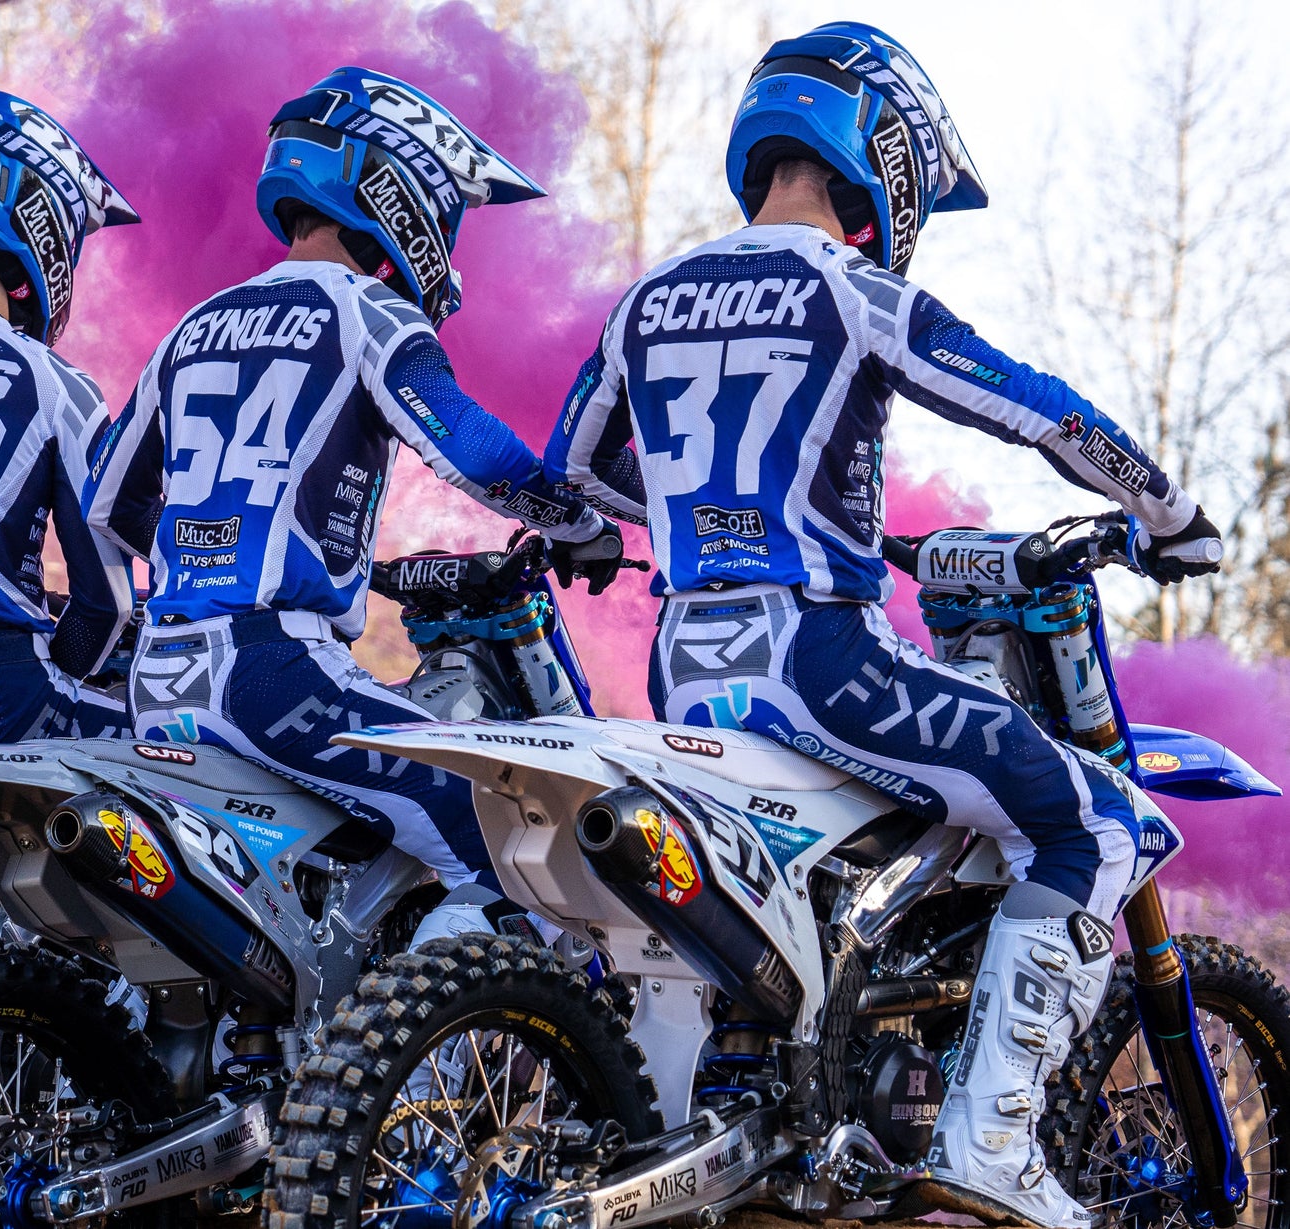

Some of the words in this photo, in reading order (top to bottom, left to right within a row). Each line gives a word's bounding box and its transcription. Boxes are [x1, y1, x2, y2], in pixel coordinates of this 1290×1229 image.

[865, 69, 940, 192] RIDE
[356, 116, 461, 213] RIDE
[4, 134, 88, 231] RIDE
[882, 131, 916, 264] Muc-Off
[368, 172, 445, 288] Muc-Off
[24, 196, 71, 312] Muc-Off
[637, 278, 820, 336] SCHOCK
[170, 305, 331, 367] REYNOLDS
[930, 347, 1009, 386] CLUBMX
[398, 386, 451, 439] CLUBMX
[563, 371, 595, 436] CLUBMX
[645, 337, 814, 496] 37
[166, 358, 311, 507] 54
[1088, 430, 1148, 490] Muc-Off
[335, 481, 364, 506] Mika
[399, 560, 461, 591] Mika
[930, 546, 1006, 581] Mika
[938, 572, 981, 581] Metals
[825, 662, 1013, 756] FXR
[138, 745, 194, 762] GUTS
[473, 732, 574, 751] DUNLOP
[667, 735, 722, 755] GUTS
[817, 747, 912, 795] YAMAHA
[1138, 754, 1180, 768] FMF
[223, 797, 277, 821] FXR
[748, 795, 798, 822] FXR
[255, 825, 284, 840] POWER
[1139, 832, 1166, 851] MAHA
[642, 949, 673, 958] ICON
[1014, 972, 1047, 1016] G
[528, 1016, 558, 1037] EXCEL
[955, 988, 991, 1088] GAERNE
[1255, 1019, 1277, 1048] EXCEL
[890, 1103, 940, 1117] HINSON
[213, 1120, 254, 1153] YAMALUBE
[120, 1166, 150, 1183] DUBYA
[156, 1144, 206, 1184] Mika
[120, 1180, 147, 1202] FLO
[614, 1189, 642, 1206] DUBYA
[649, 1166, 697, 1208] Mika
[610, 1202, 639, 1226] FLO
